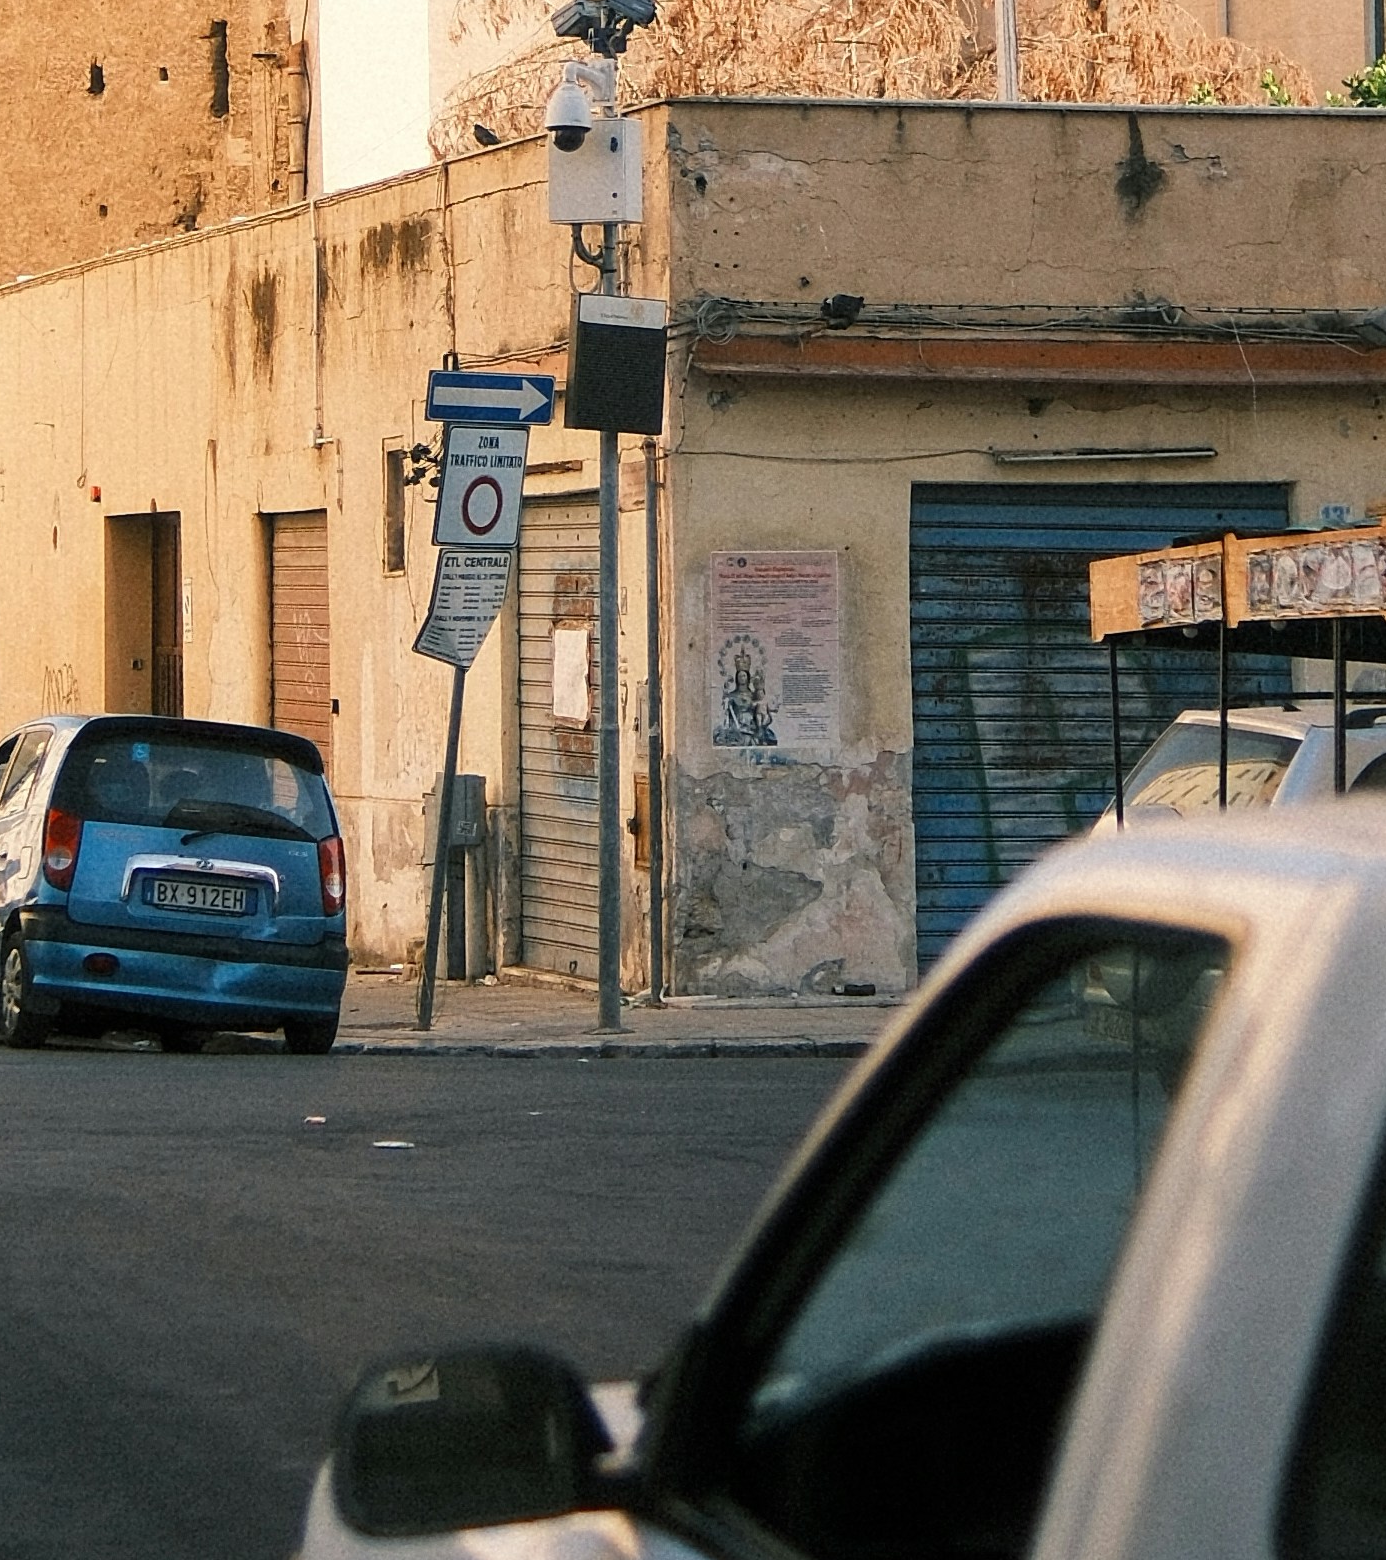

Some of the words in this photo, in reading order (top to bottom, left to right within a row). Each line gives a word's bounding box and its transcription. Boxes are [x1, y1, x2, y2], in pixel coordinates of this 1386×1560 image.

[478, 436, 500, 449] ZONA
[450, 454, 488, 468] TRAFFICO
[490, 455, 523, 468] LIMITATO
[444, 557, 461, 567] ZTL
[464, 557, 509, 568] CENTRALE
[157, 883, 179, 903] BX
[187, 886, 244, 910] 912EH
